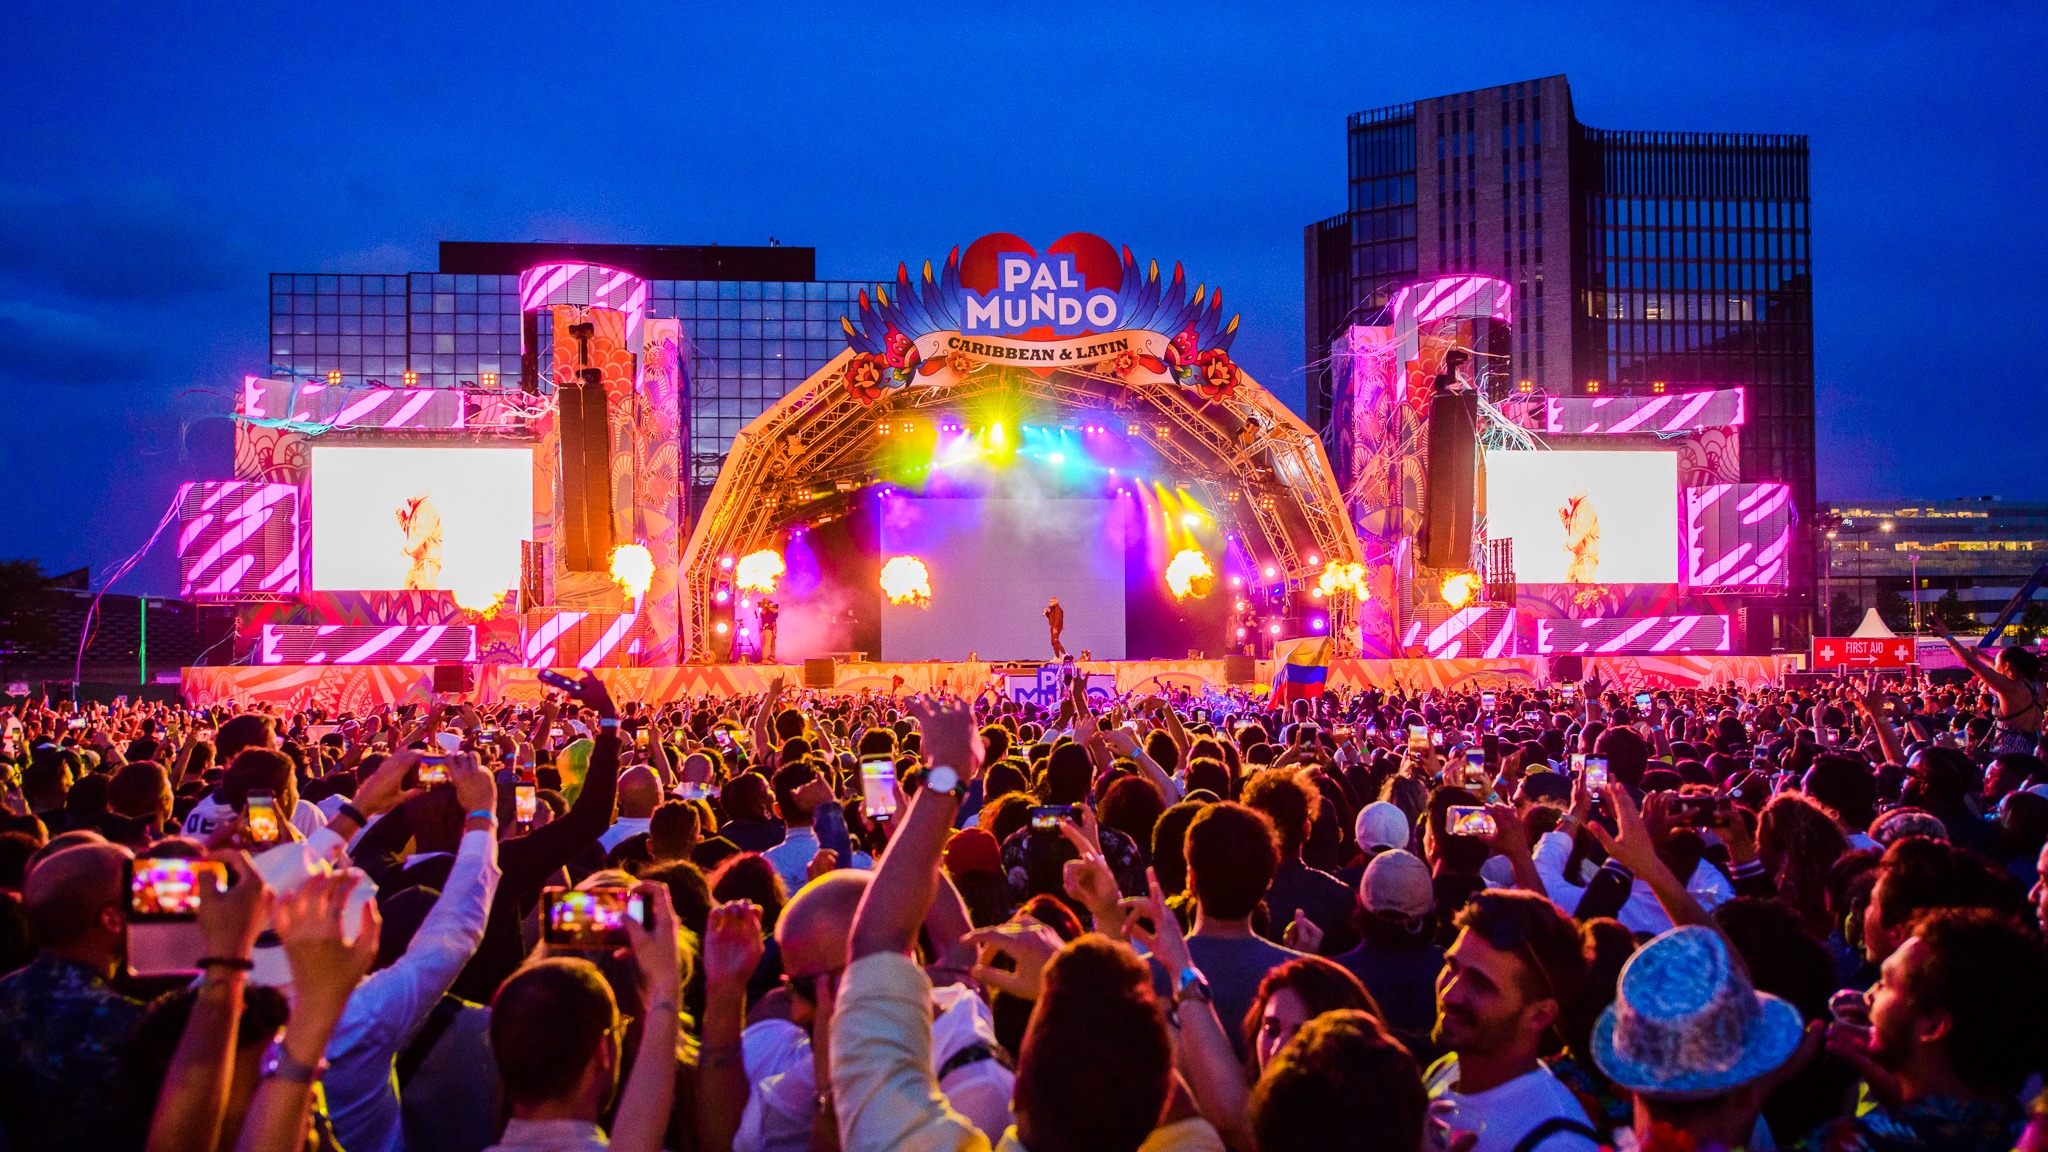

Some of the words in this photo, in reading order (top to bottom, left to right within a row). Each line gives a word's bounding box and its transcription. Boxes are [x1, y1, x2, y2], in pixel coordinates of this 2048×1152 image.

[1004, 259, 1078, 292] PAL
[966, 292, 1117, 329] MUNDO
[947, 337, 1055, 361] CARIBBEAN
[1059, 349, 1073, 360] &
[1077, 338, 1129, 359] LATIN
[1845, 642, 1868, 654] FIRST
[1870, 642, 1884, 654] AID
